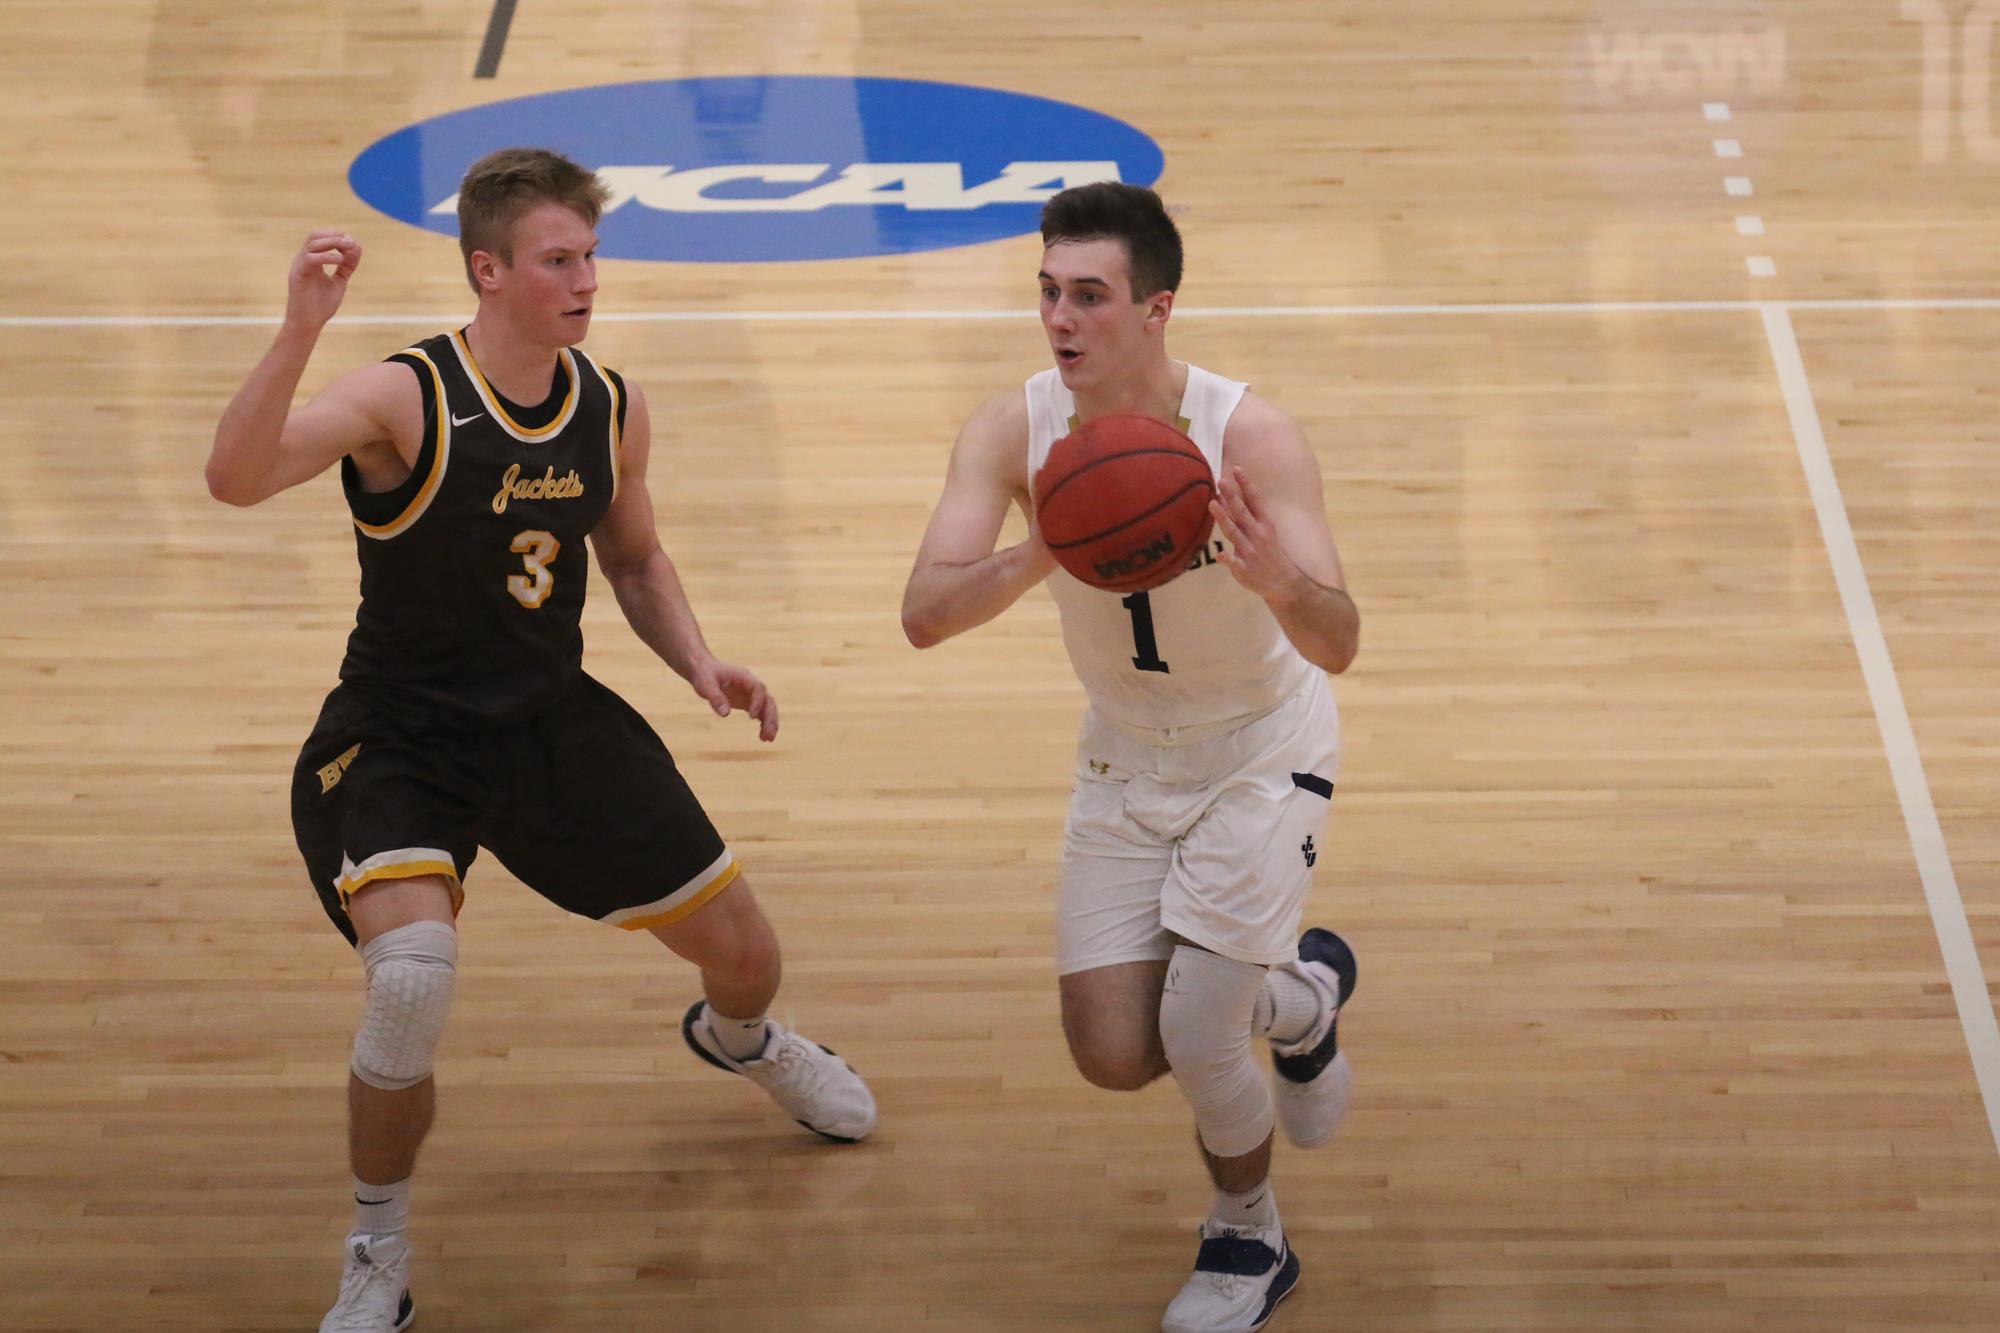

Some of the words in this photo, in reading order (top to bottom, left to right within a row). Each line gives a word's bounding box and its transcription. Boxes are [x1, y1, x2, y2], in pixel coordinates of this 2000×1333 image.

[492, 463, 584, 514] Jackets
[507, 529, 561, 609] 3
[1122, 591, 1171, 674] 1
